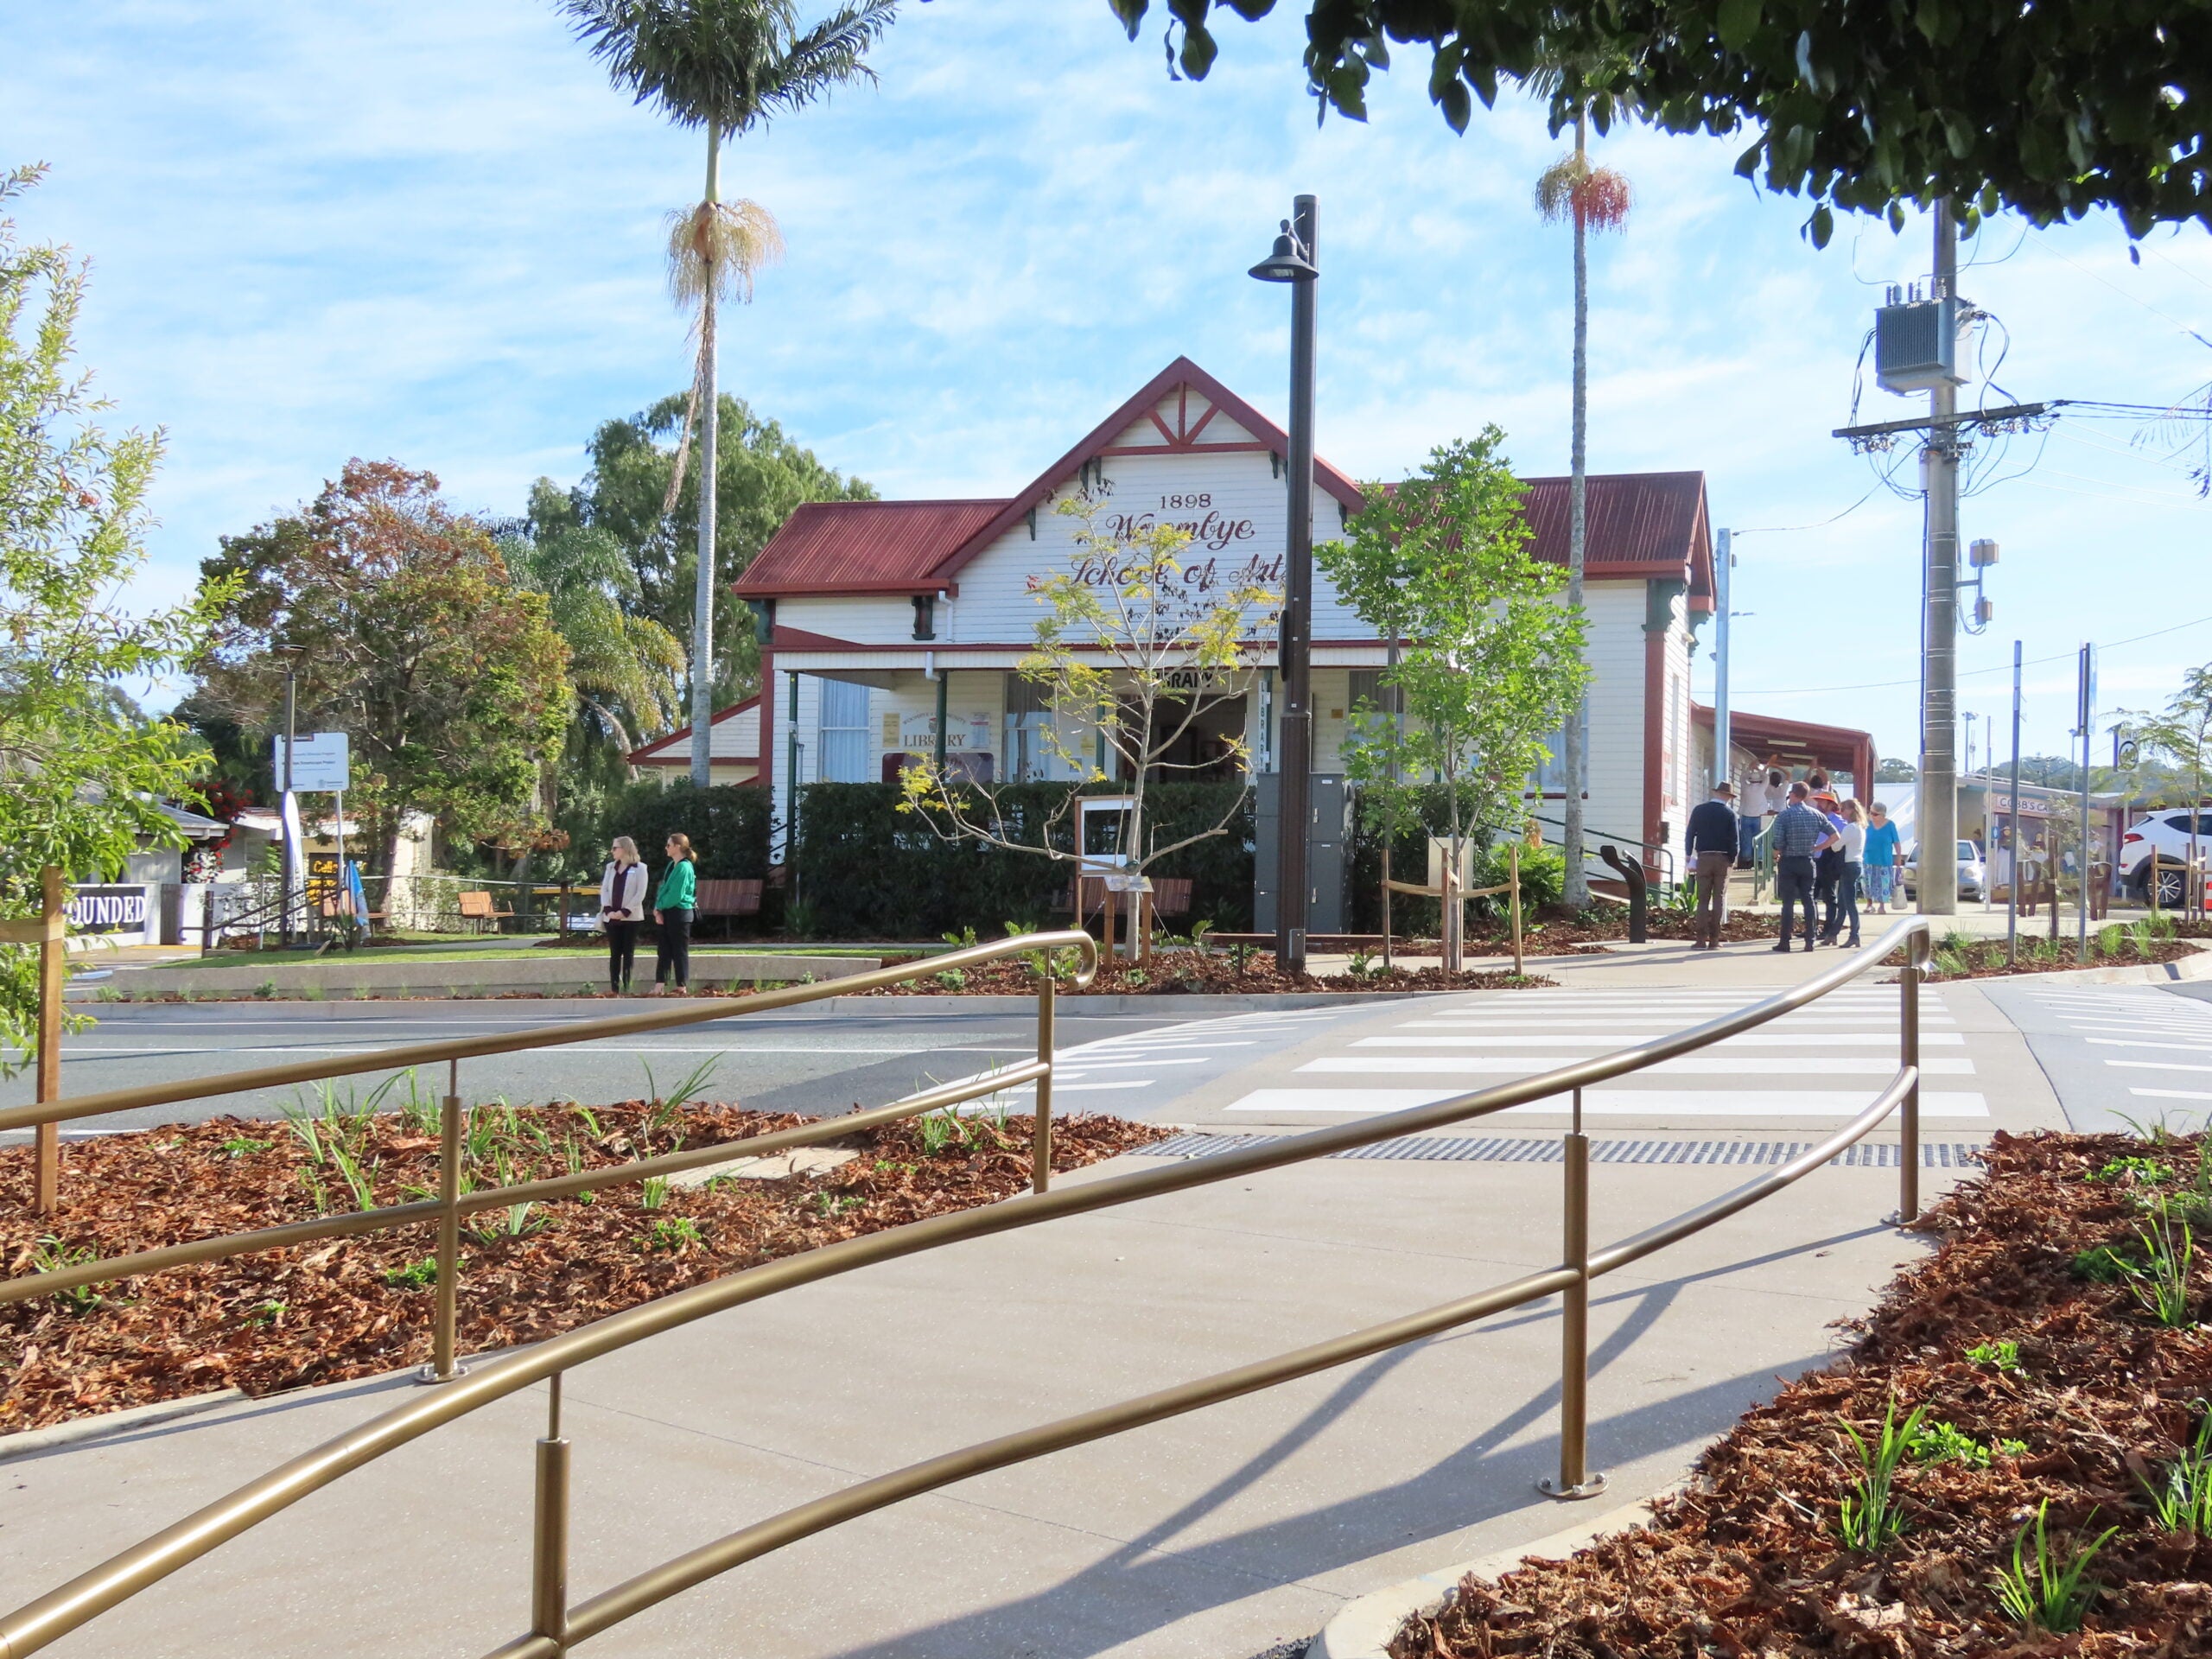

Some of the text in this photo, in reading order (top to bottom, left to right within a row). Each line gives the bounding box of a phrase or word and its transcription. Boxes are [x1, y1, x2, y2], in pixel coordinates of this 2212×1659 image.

[1160, 493, 1211, 509] 1898
[1184, 557, 1216, 593] of
[905, 734, 966, 747] LIBRRY
[63, 895, 145, 925] OUNDED
